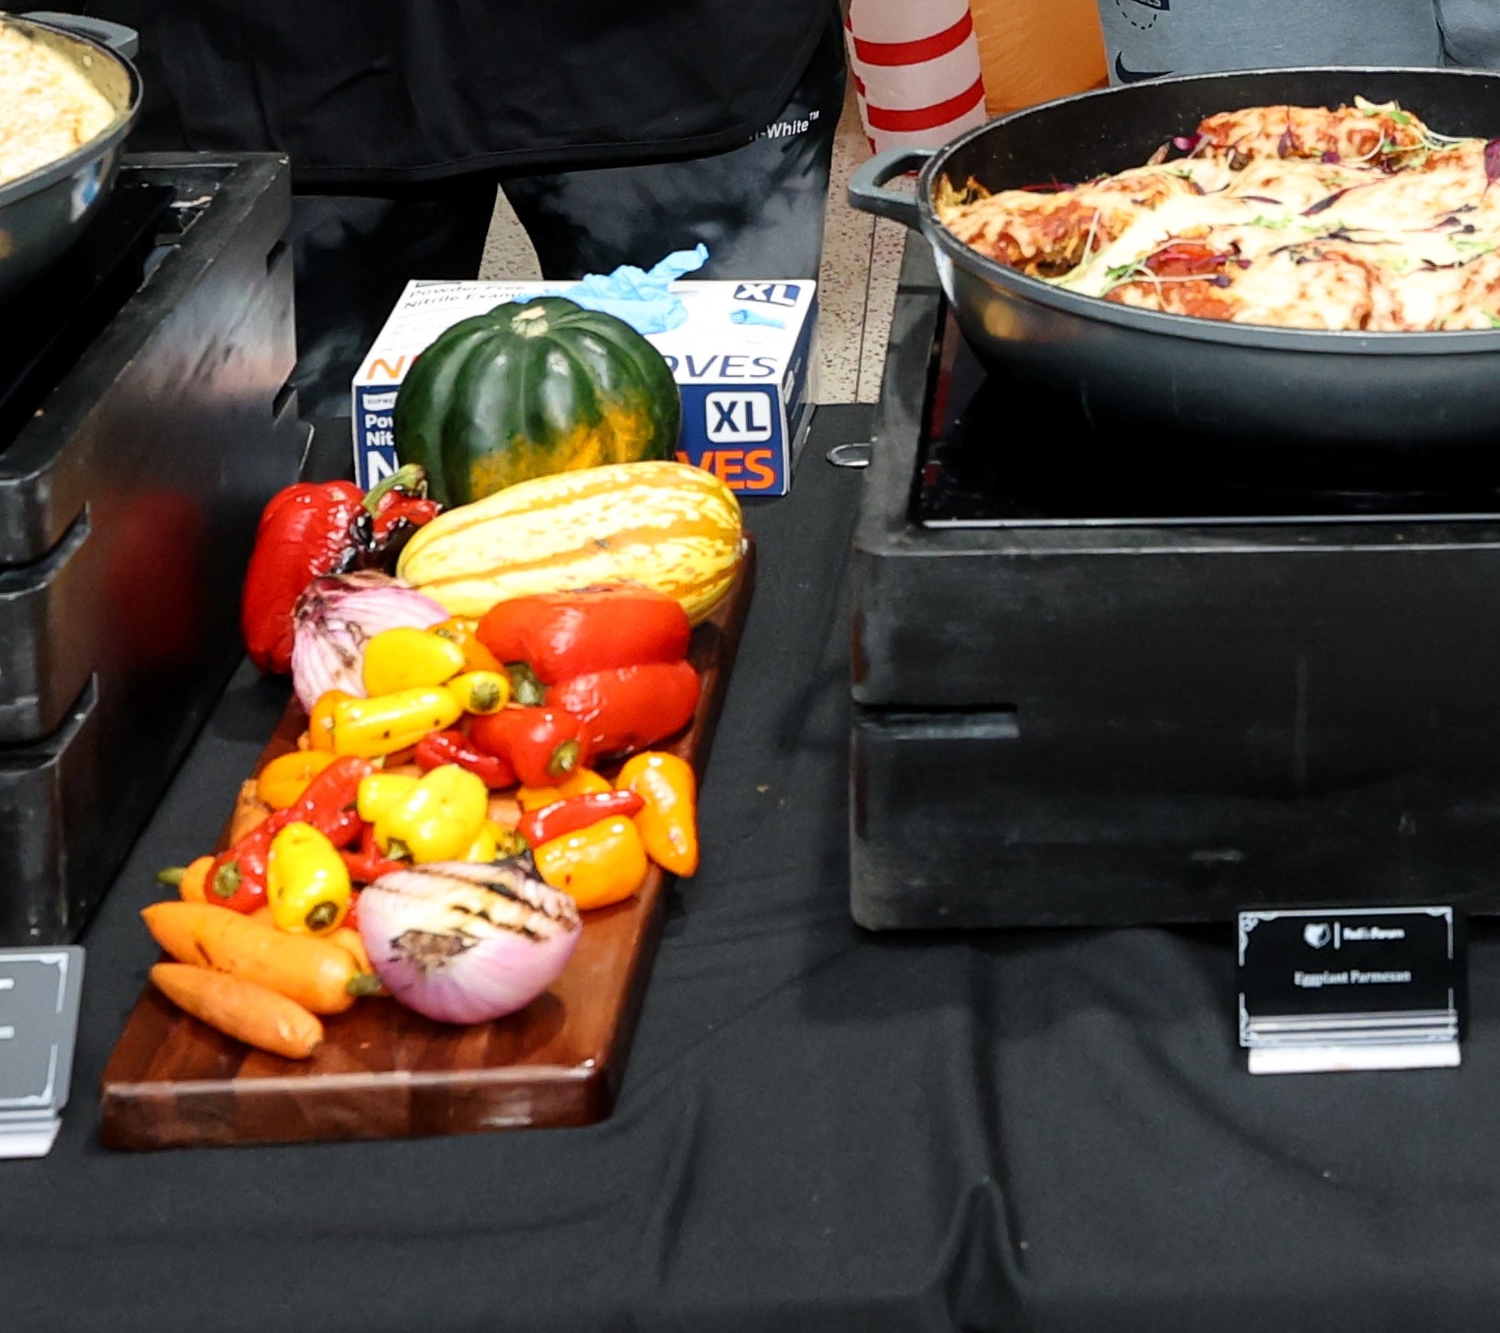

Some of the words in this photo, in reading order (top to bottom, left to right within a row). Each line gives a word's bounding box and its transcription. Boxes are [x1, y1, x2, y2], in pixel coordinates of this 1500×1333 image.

[739, 284, 798, 306] XL
[712, 400, 768, 433] XL
[1294, 969, 1349, 988] Eggplant
